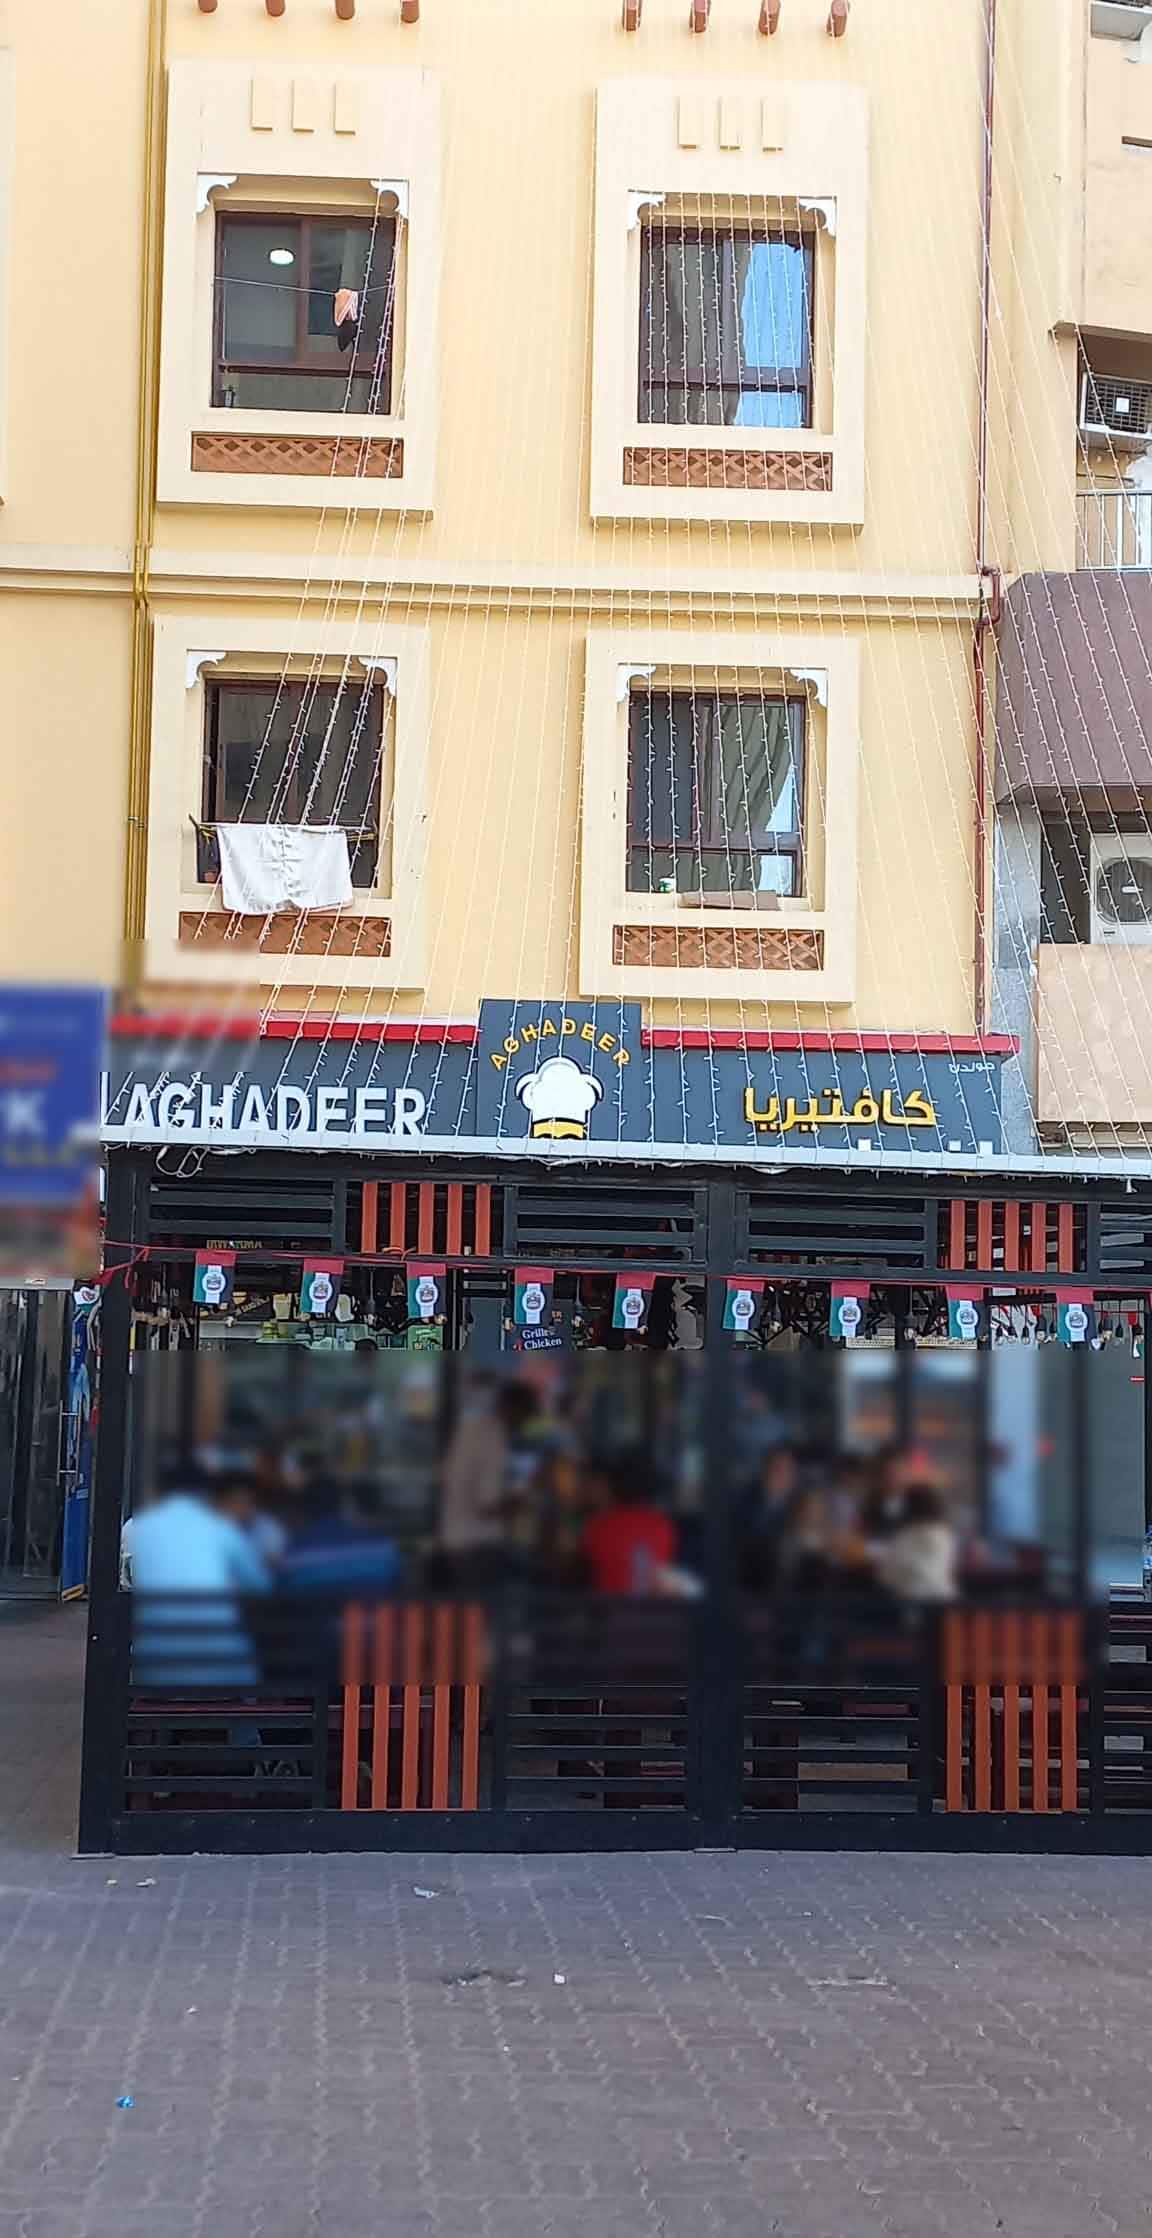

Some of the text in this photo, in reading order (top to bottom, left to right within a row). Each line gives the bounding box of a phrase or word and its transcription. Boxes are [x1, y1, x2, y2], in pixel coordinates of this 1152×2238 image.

[490, 1019, 631, 1071] AGHADEER
[124, 1082, 427, 1135] AGHADEER
[744, 1087, 937, 1131] كافتيريا
[524, 1338, 562, 1350] Chicken
